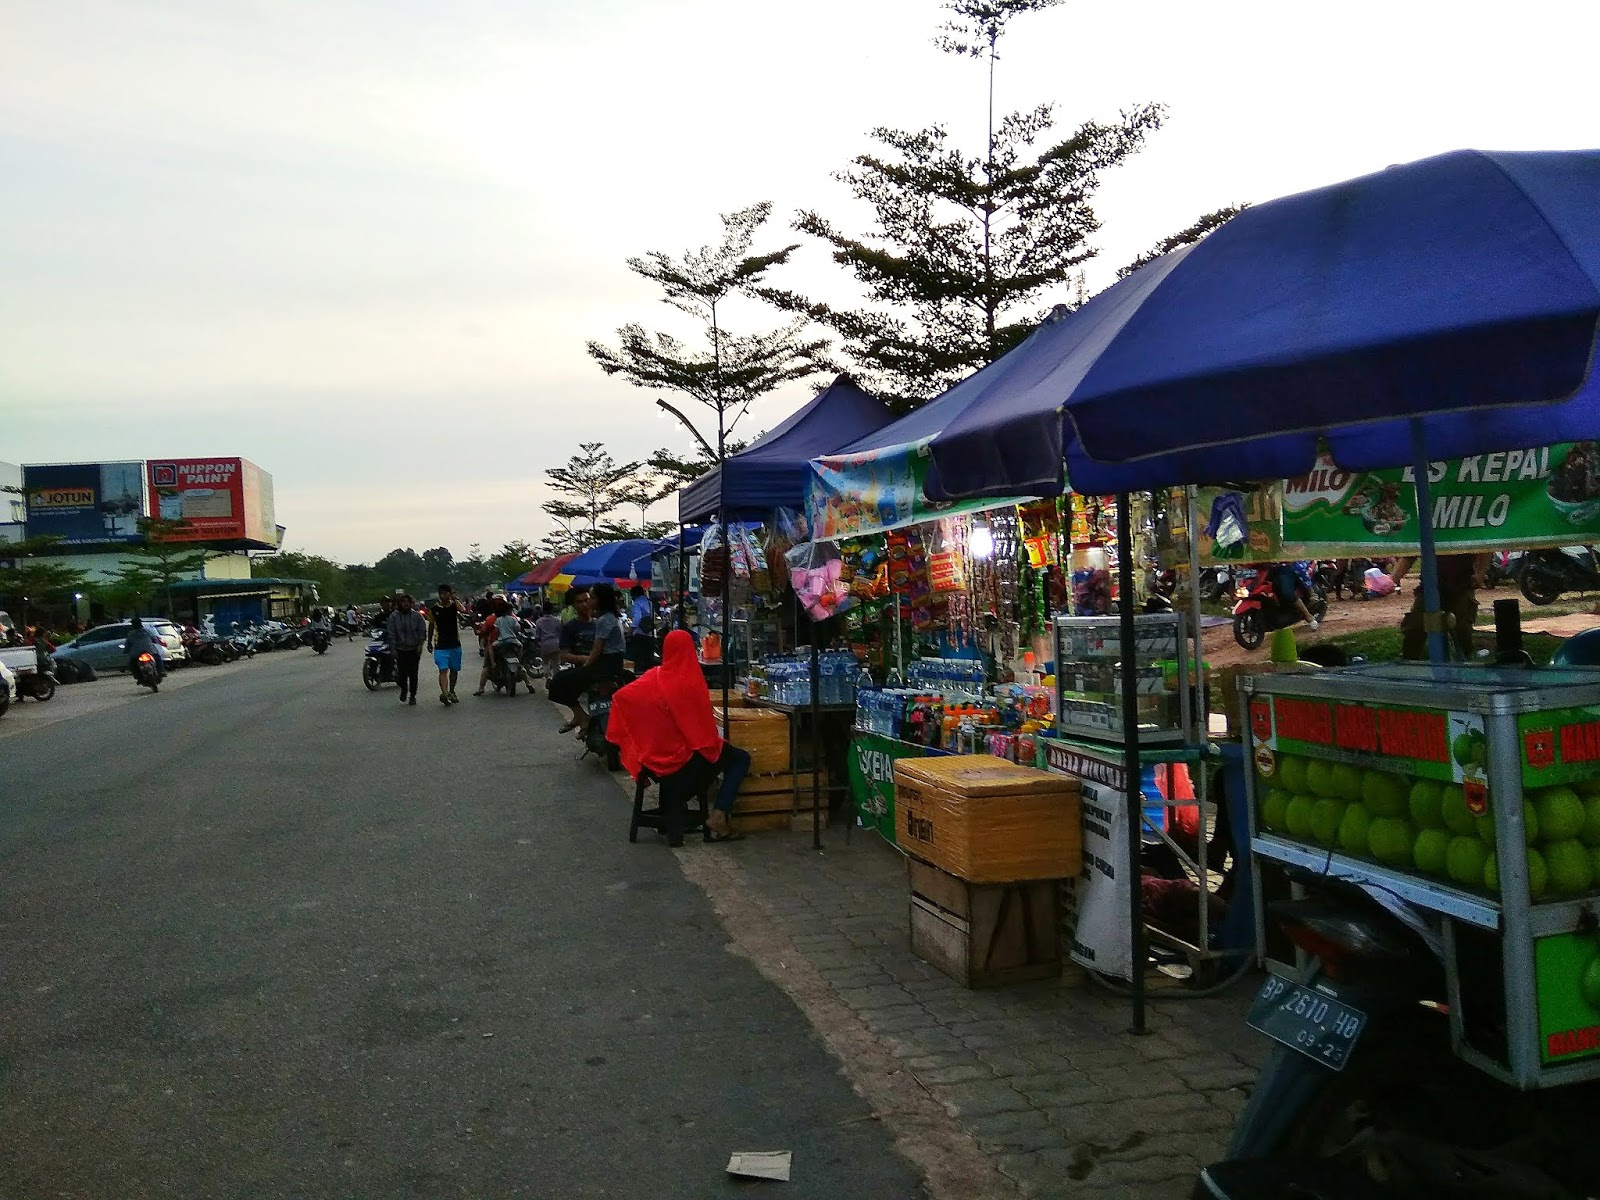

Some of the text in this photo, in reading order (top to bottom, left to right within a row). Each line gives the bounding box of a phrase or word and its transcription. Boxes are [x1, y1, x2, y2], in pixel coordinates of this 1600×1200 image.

[179, 463, 235, 474] NIPPON
[1457, 447, 1551, 483] KEPAL
[187, 473, 232, 484] PAINT
[1286, 470, 1350, 494] MILO
[47, 492, 91, 503] JOTUN
[1432, 494, 1510, 529] MILO
[1262, 978, 1284, 1002] BP
[1285, 990, 1329, 1024] 2610
